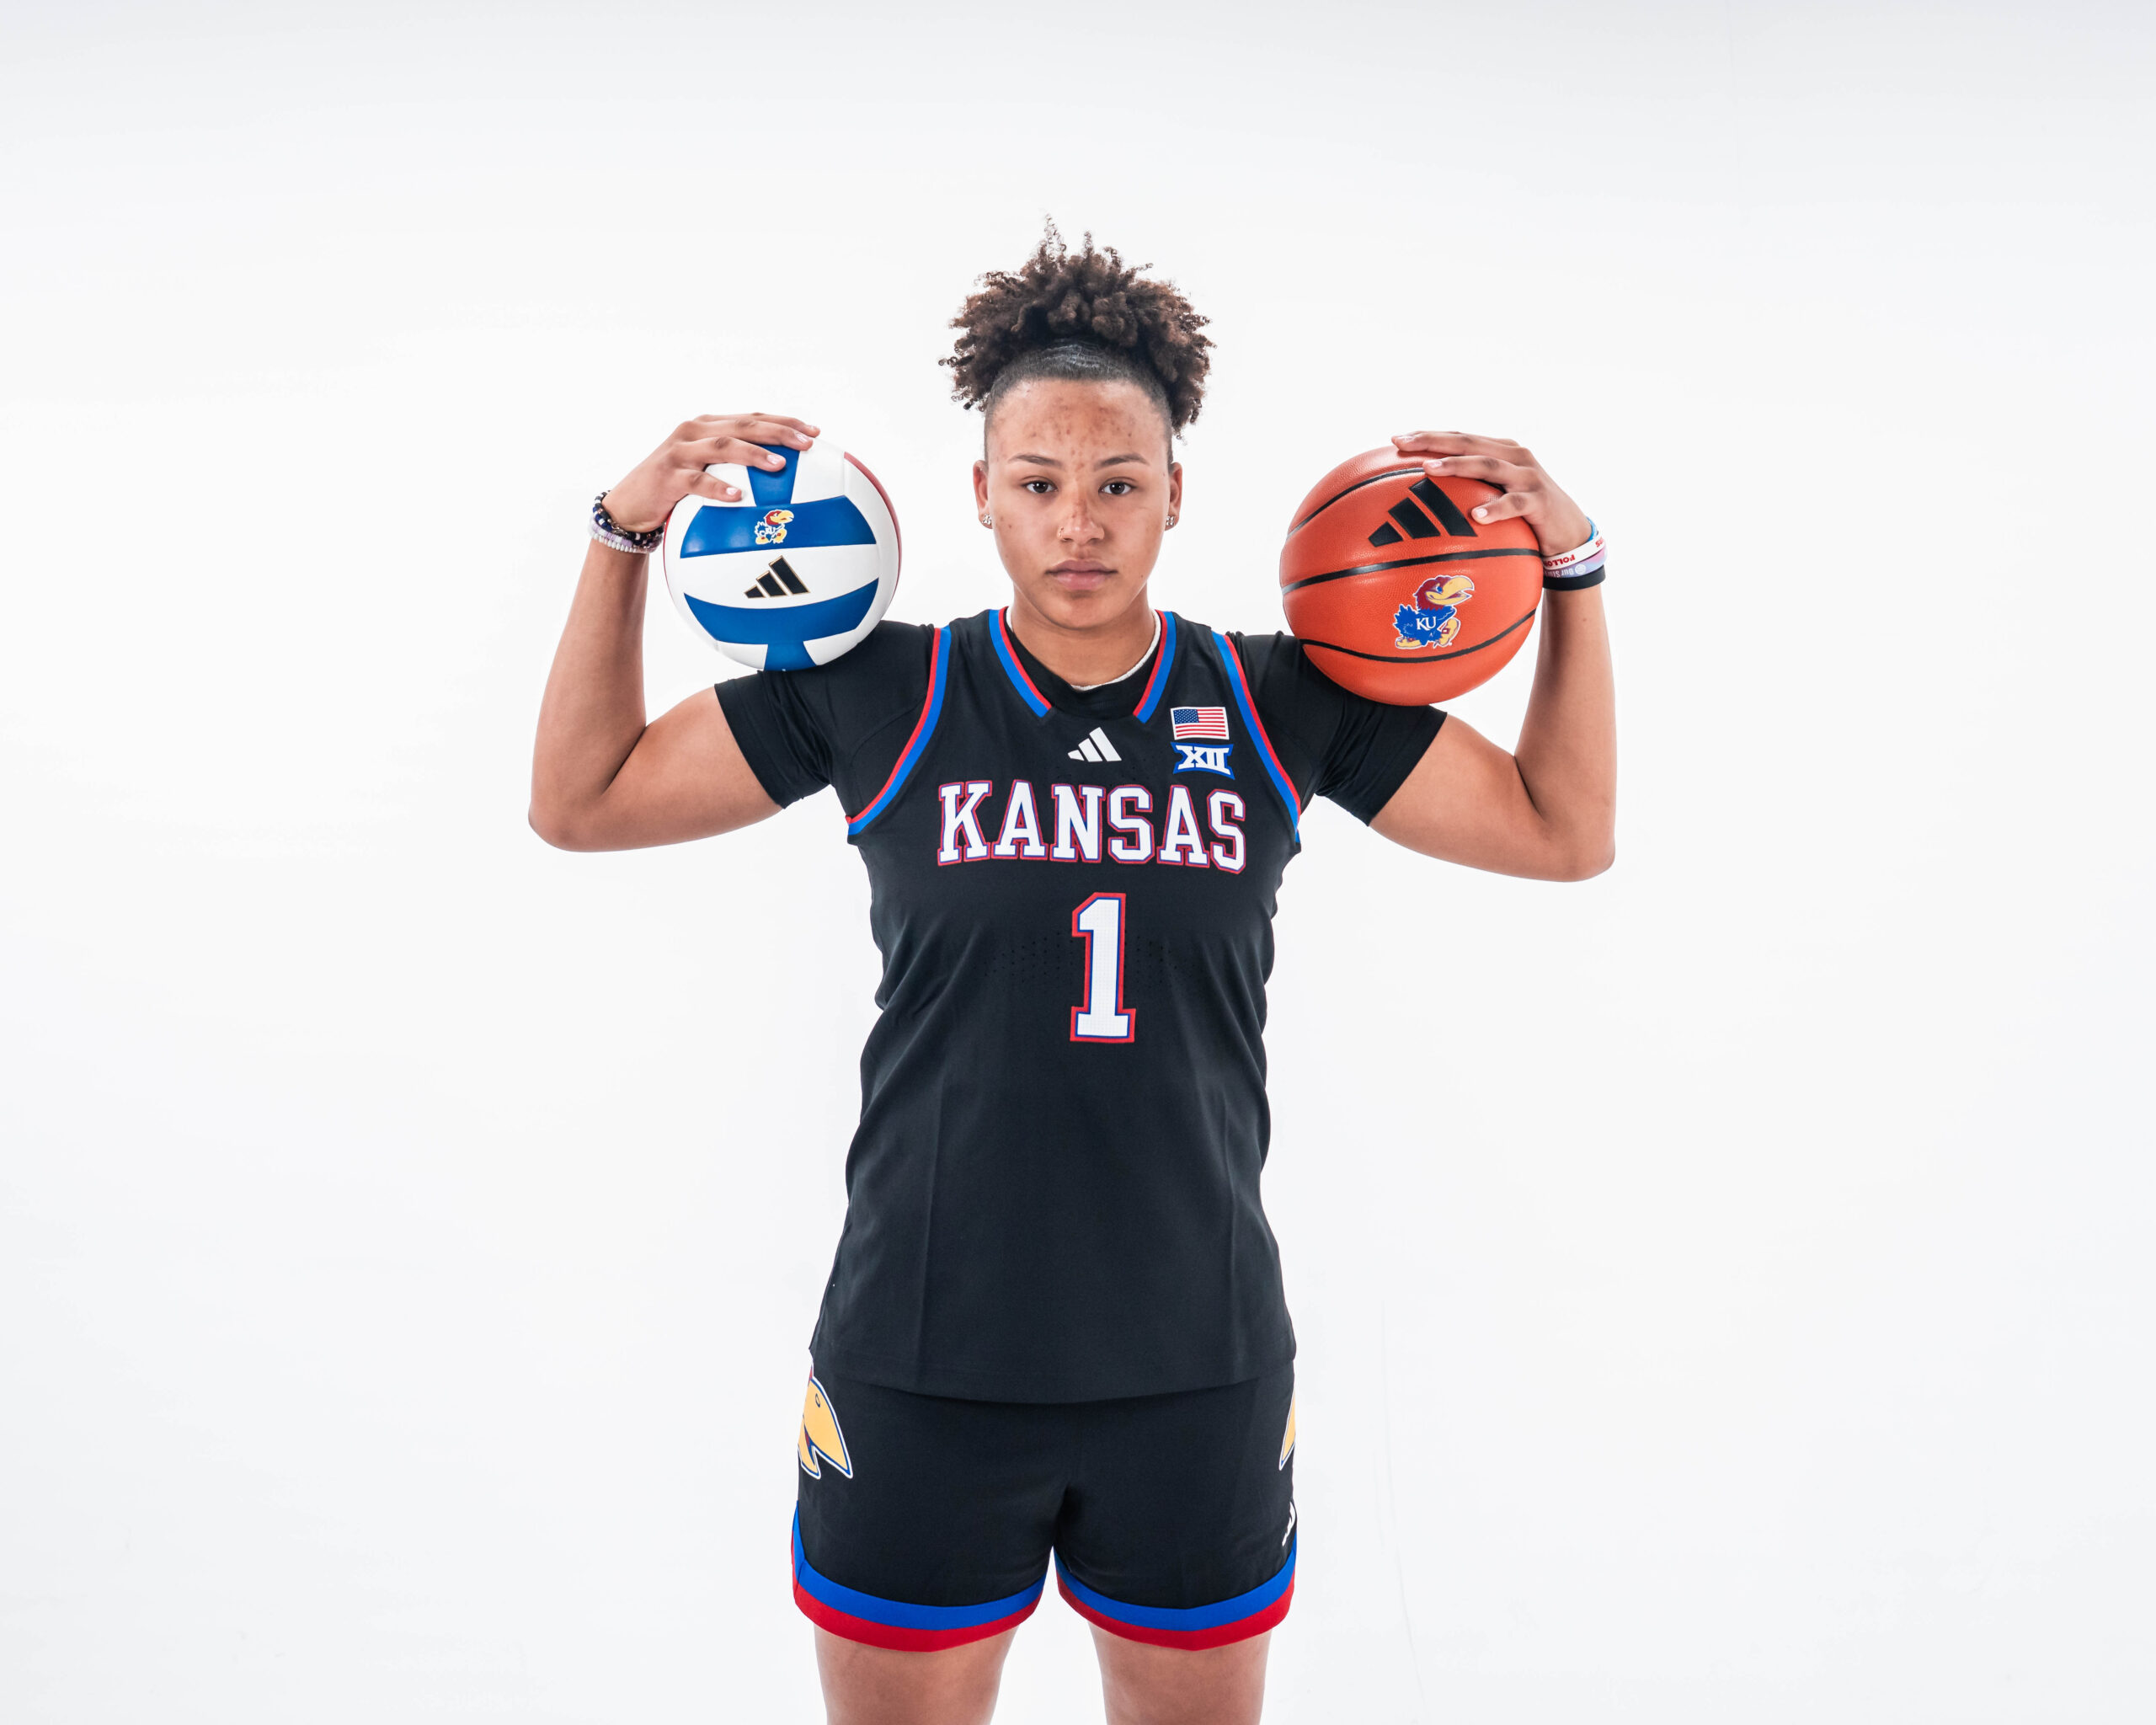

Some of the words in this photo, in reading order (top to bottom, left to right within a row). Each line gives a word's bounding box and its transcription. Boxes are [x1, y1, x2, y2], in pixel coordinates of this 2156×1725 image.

[1416, 616, 1437, 631] KU
[1175, 744, 1231, 776] XII
[937, 779, 1246, 874] KANSAS
[1070, 892, 1136, 1044] 1
